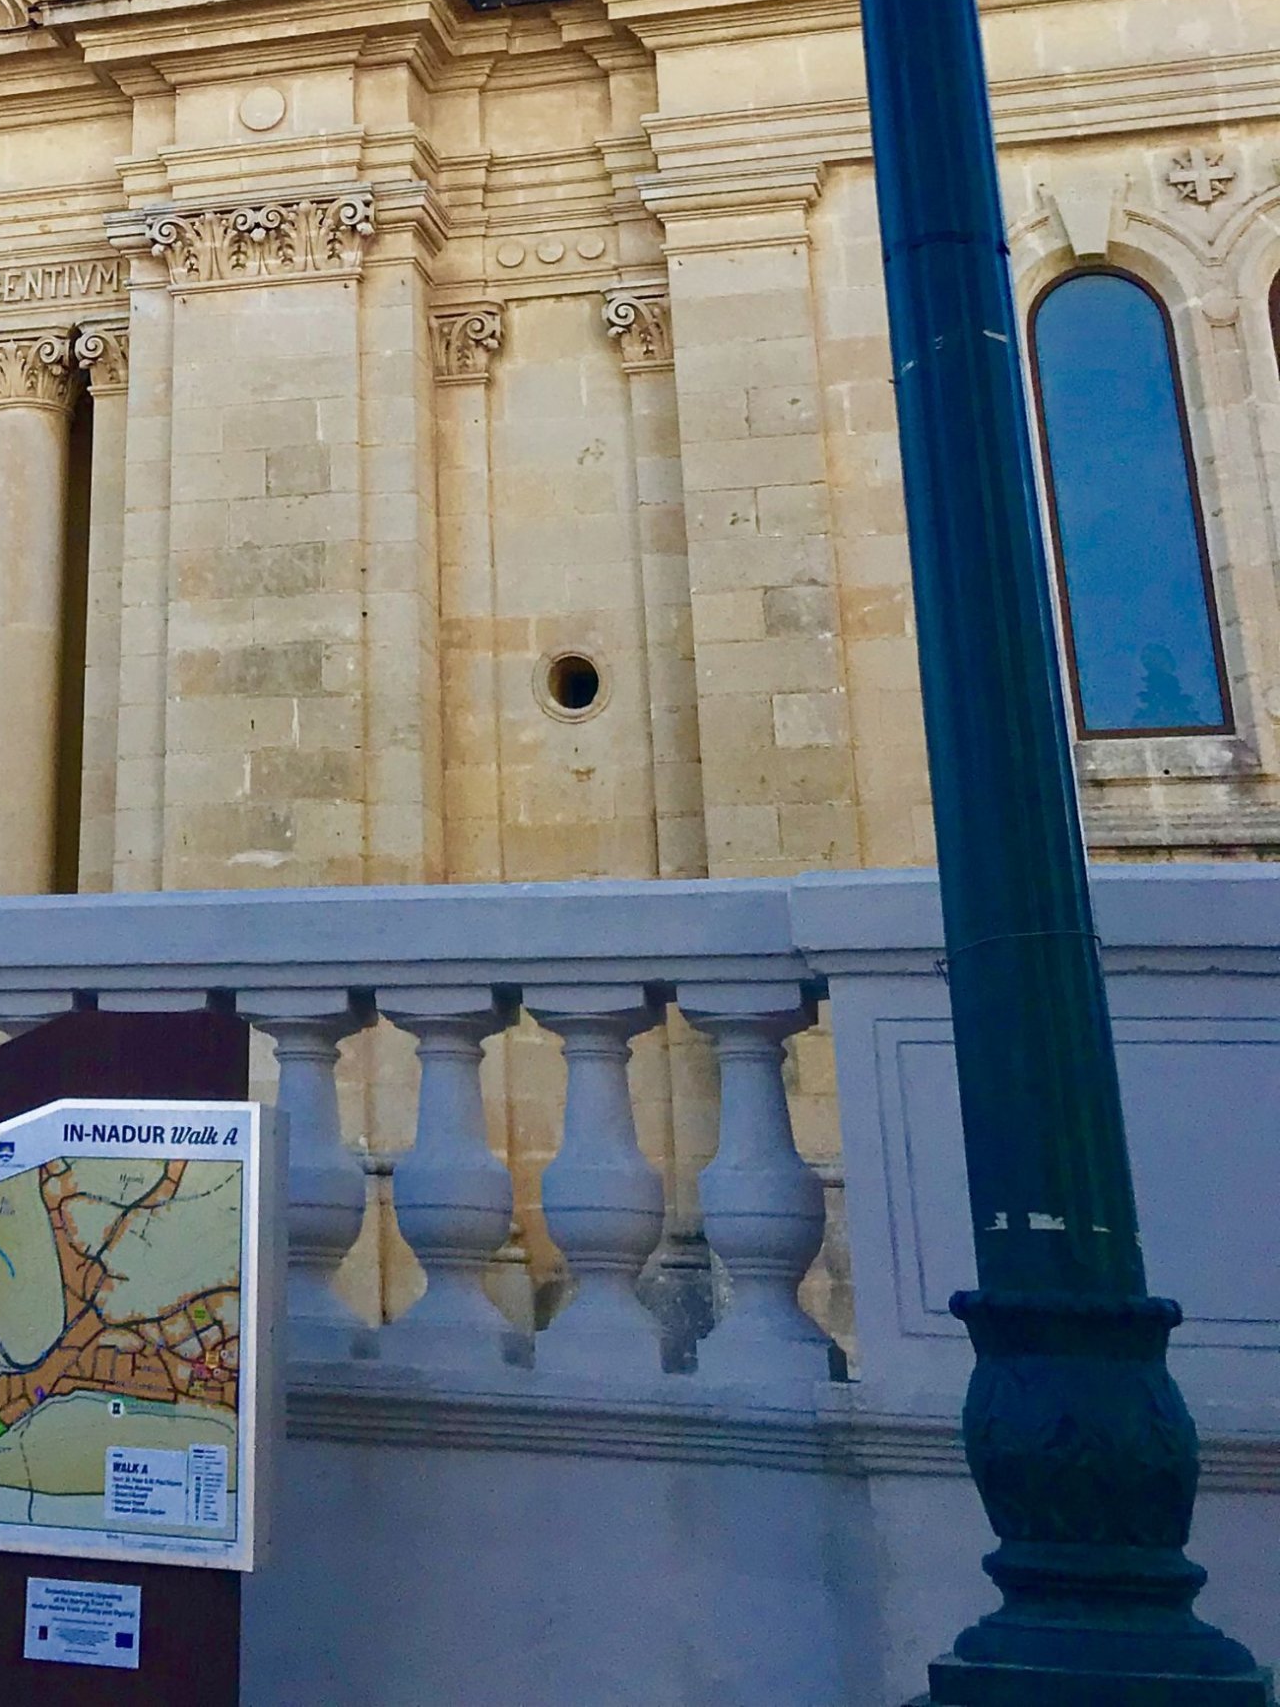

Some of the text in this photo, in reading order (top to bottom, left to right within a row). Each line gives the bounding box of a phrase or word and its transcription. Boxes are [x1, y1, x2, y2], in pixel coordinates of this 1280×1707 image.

[63, 1124, 238, 1145] IN-NADUR Walk A
[112, 1461, 148, 1474] WALK A
